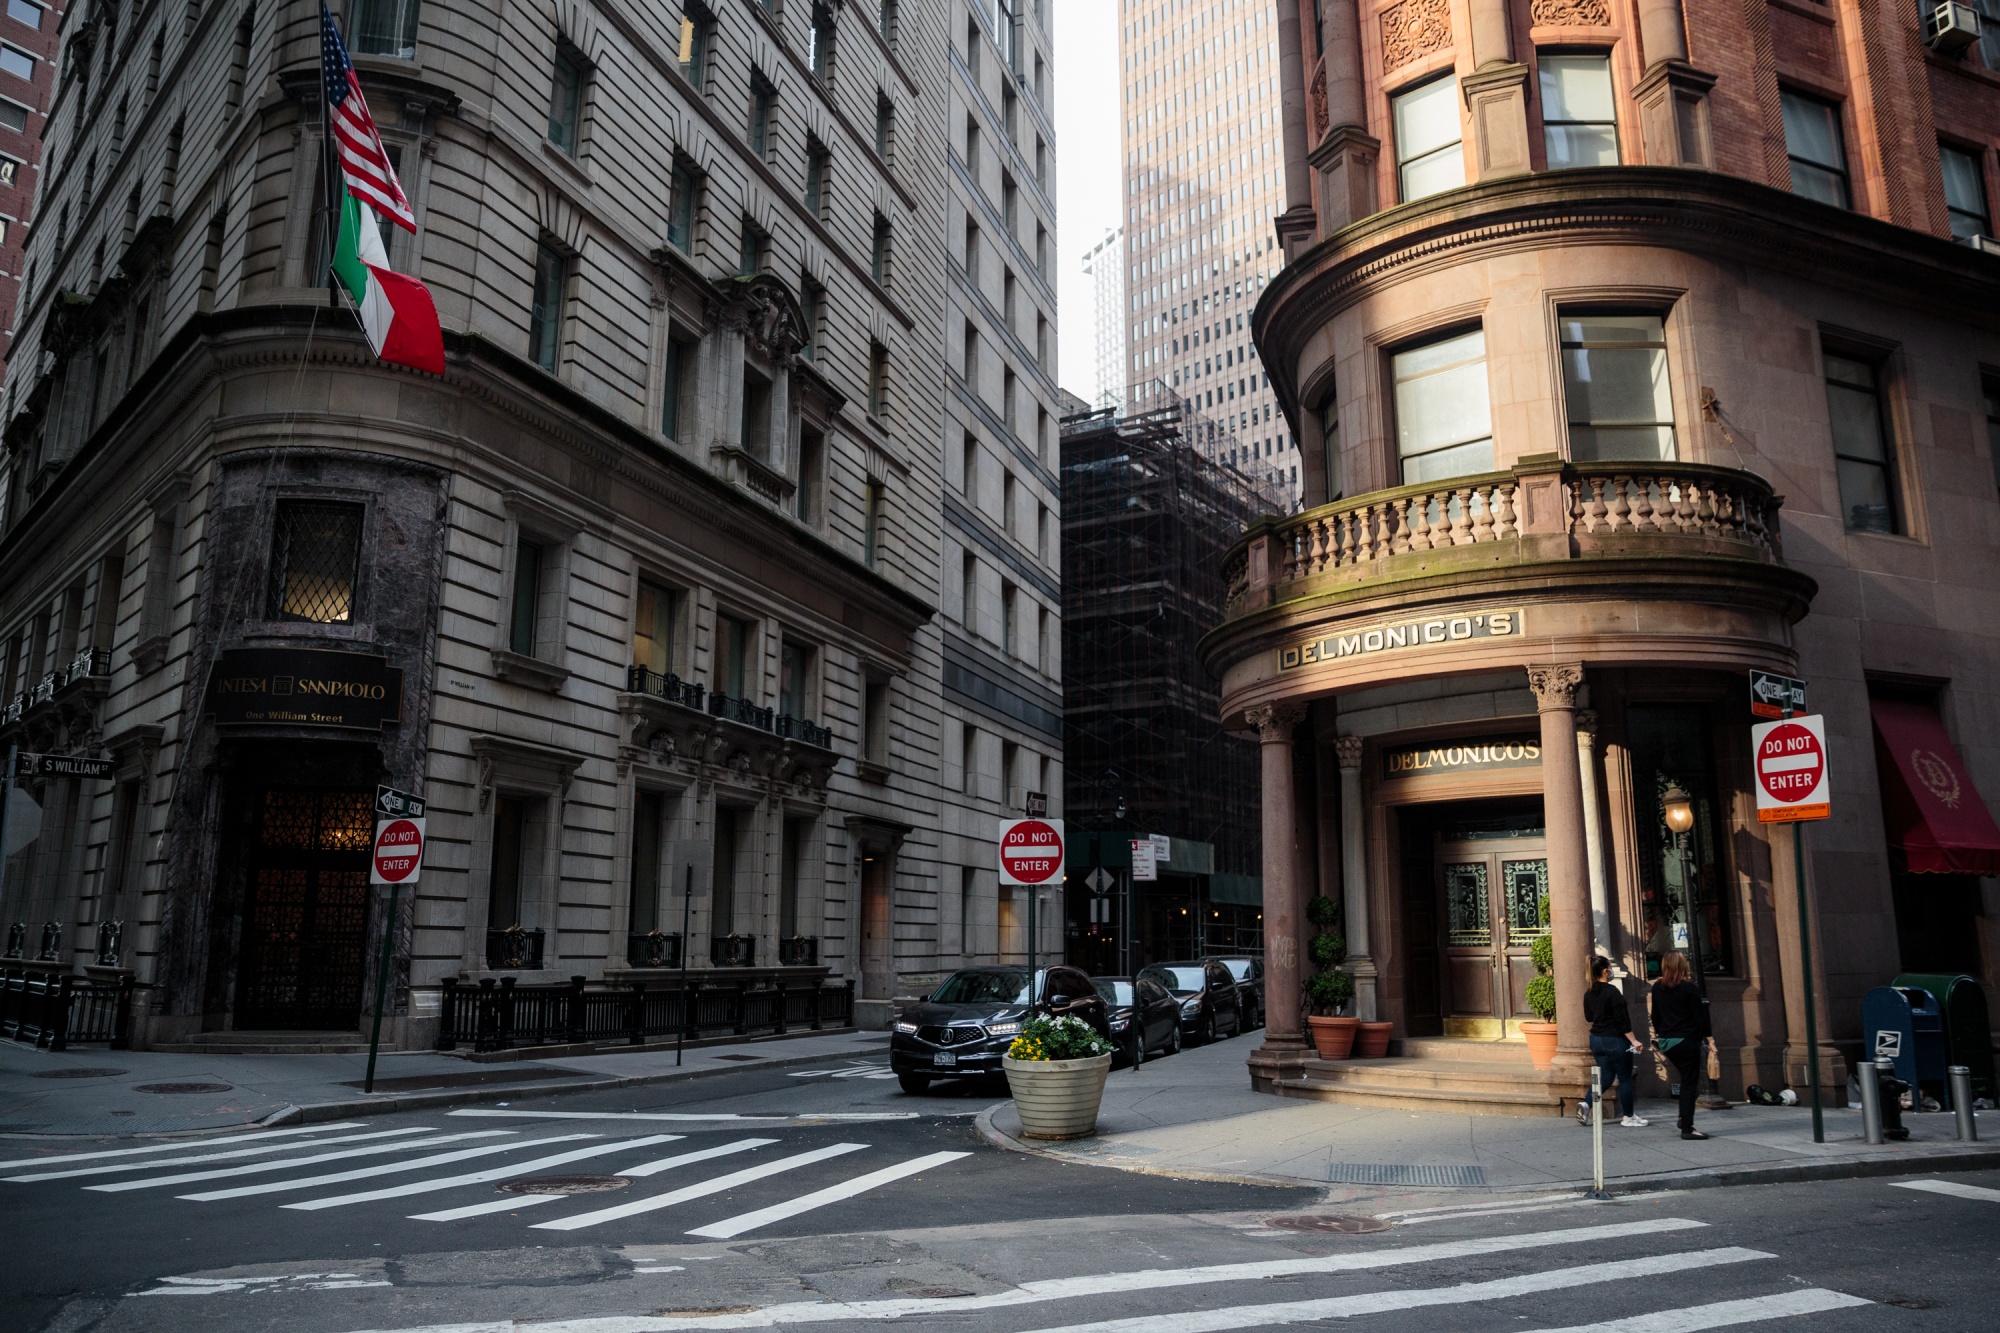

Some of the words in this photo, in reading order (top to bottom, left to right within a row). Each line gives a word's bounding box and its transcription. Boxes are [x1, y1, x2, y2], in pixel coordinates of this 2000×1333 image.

[1282, 613, 1513, 669] DELMONICO'S
[218, 677, 267, 694] INTESA
[298, 678, 385, 700] SANPAOLO
[1760, 682, 1777, 697] ONE
[246, 711, 265, 720] One
[268, 711, 307, 721] William
[311, 713, 343, 723] Street
[1765, 740, 1783, 754] DO
[1787, 736, 1811, 752] NOT
[45, 760, 53, 771] S
[55, 760, 100, 775] WILLIAM
[1769, 773, 1813, 790] ENTER
[385, 795, 399, 808] ONE
[384, 832, 396, 843] DO
[398, 831, 415, 842] NOT
[1009, 832, 1025, 843] DO
[1031, 832, 1053, 843] NOT
[382, 860, 410, 870] ENTER
[1014, 861, 1049, 871] ENTER
[1677, 926, 1689, 941] A
